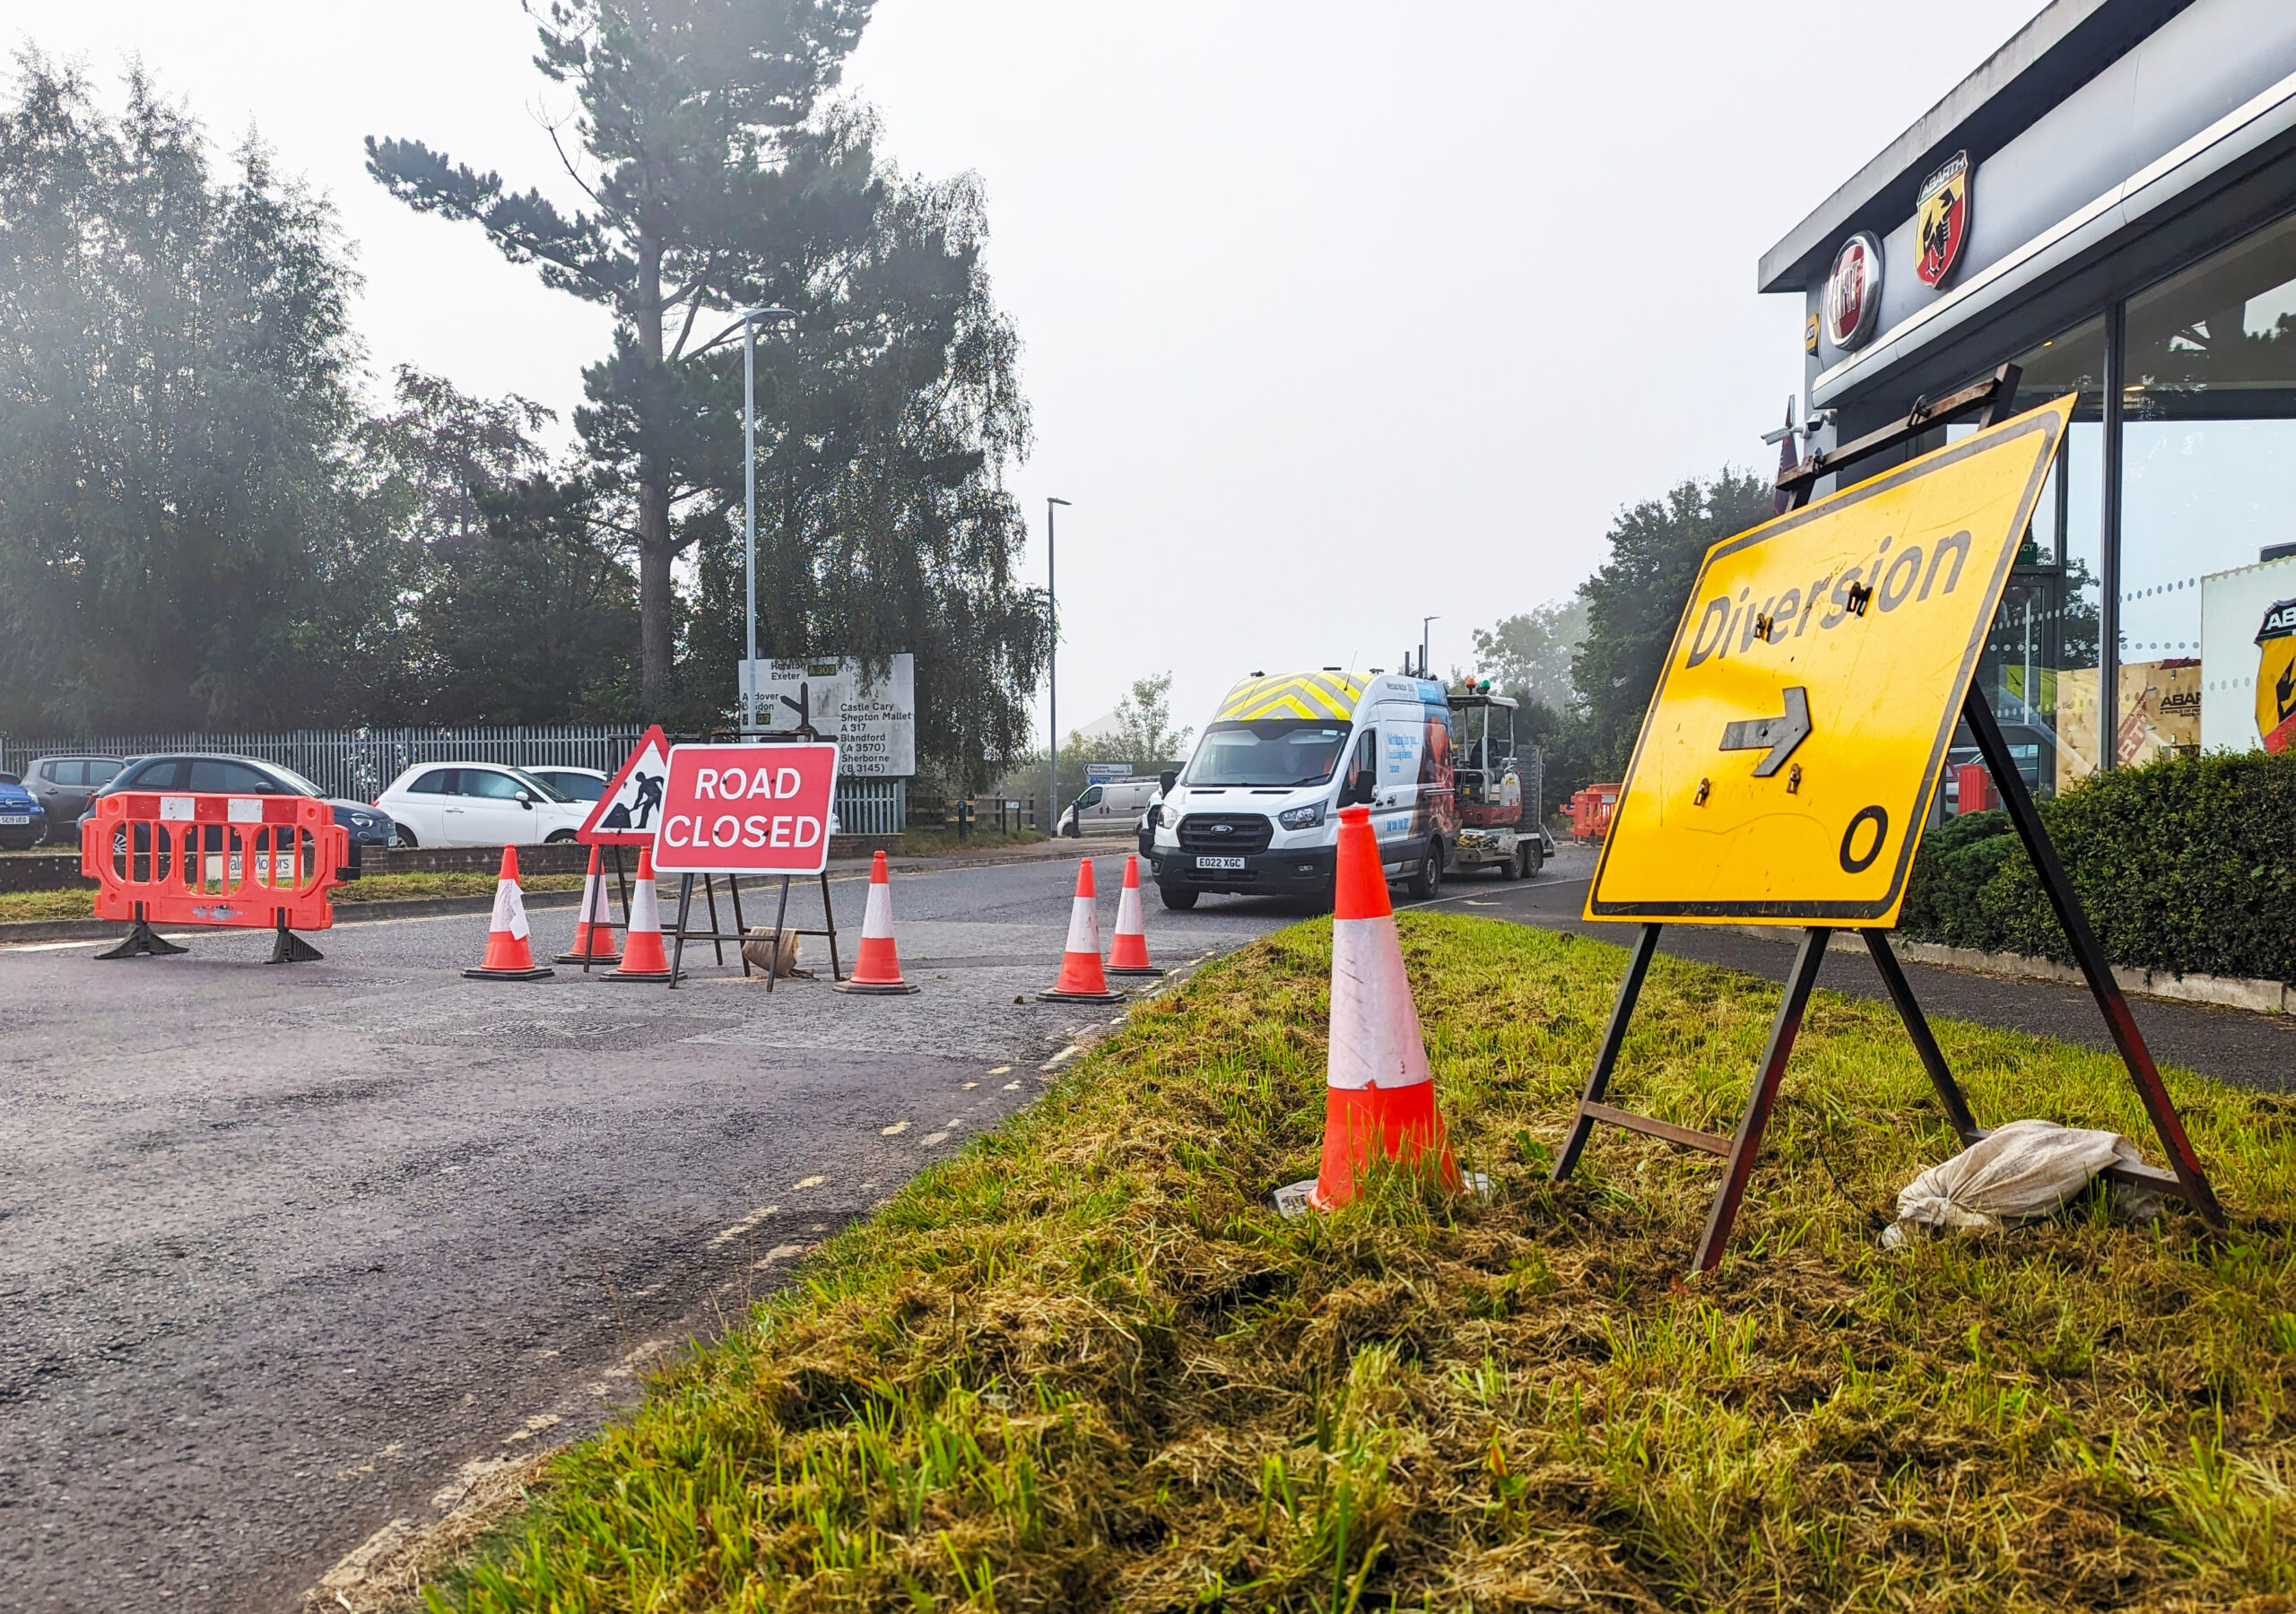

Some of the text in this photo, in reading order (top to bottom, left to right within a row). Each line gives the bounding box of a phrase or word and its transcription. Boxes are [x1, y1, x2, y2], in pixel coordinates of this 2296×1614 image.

[1919, 157, 1964, 201] ABARTH
[1831, 258, 1861, 324] FIAT
[1685, 529, 1972, 669] Diversion
[817, 666, 835, 674] 303
[743, 692, 778, 701] Adover
[743, 703, 774, 711] Ldon
[840, 702, 894, 712] Castle Cary
[840, 711, 912, 723] Shepton Mallet
[840, 723, 866, 733] A 317
[840, 733, 886, 742] Blandford
[841, 742, 886, 753] (A 3570)
[841, 754, 890, 763] Sherborne
[841, 763, 885, 774] (B 3145)
[694, 768, 801, 800] ROAD
[665, 815, 822, 848] CLOSED
[1200, 858, 1240, 867] EO22 XGC
